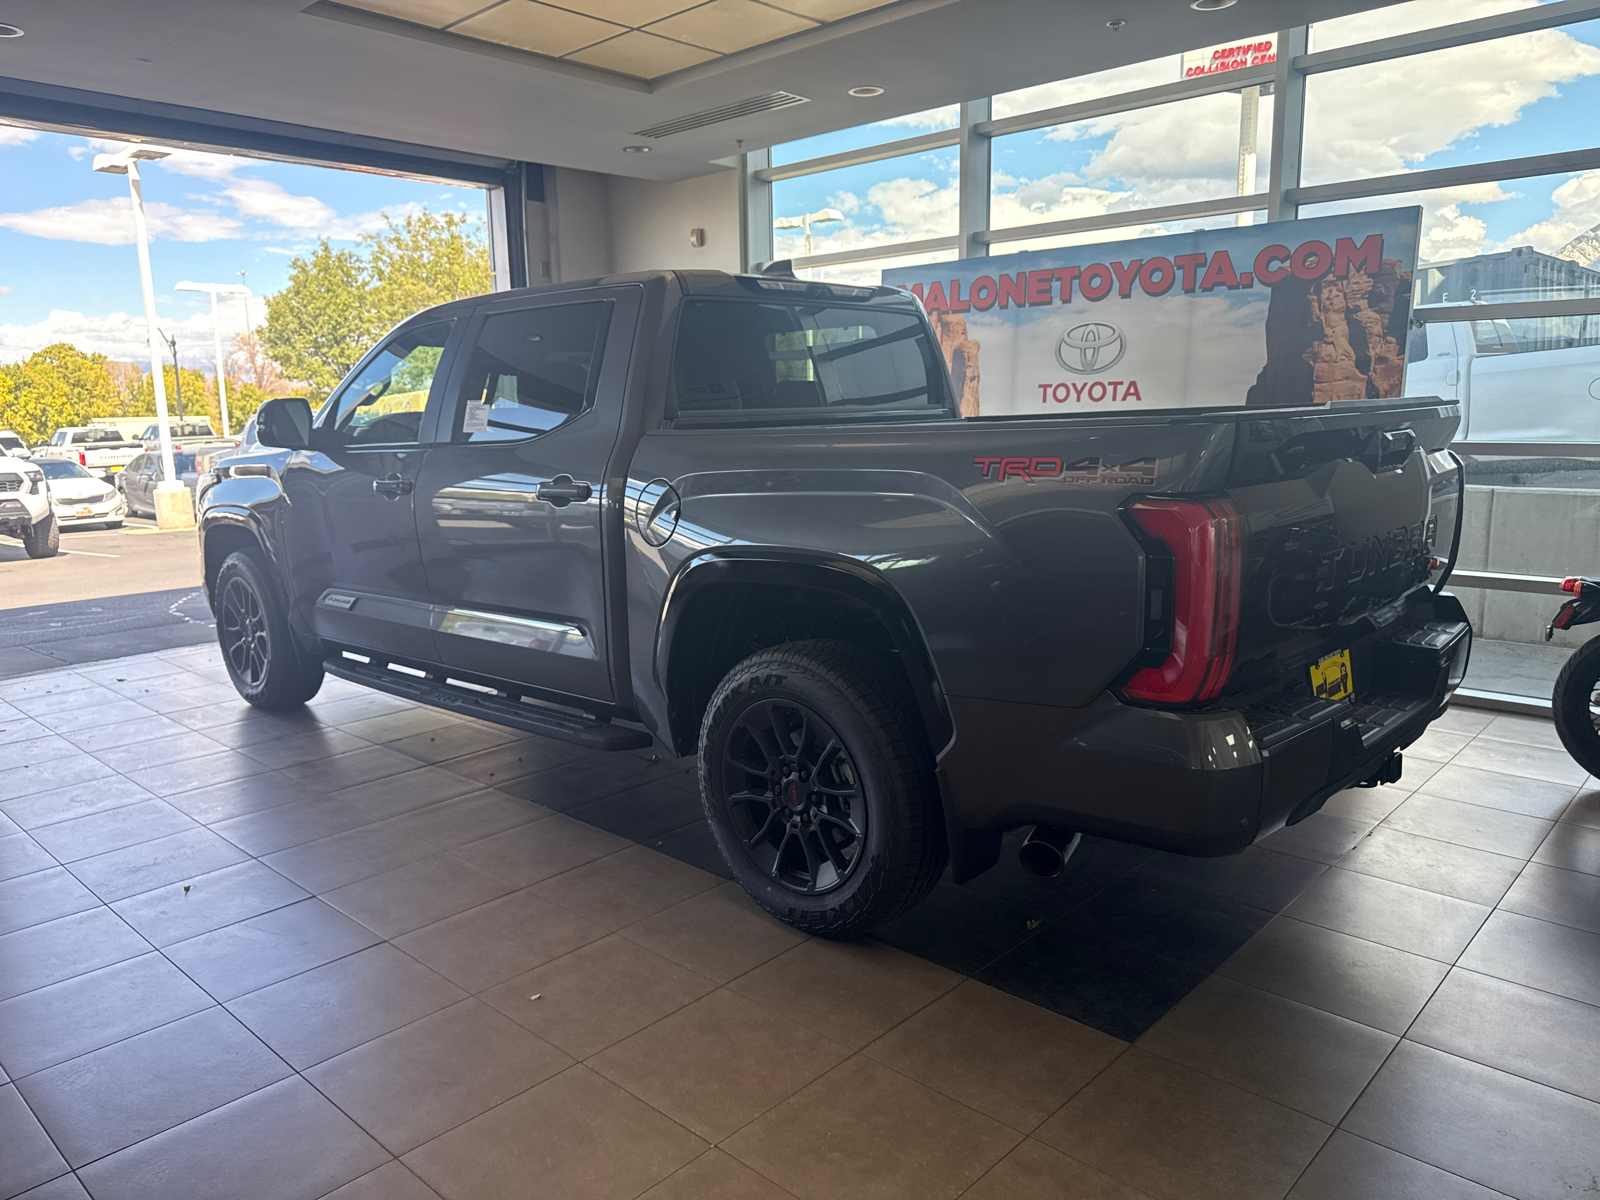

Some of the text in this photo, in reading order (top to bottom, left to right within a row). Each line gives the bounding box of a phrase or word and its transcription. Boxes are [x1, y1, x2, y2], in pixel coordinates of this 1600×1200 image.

[1212, 41, 1273, 60] CERTIFIED
[1185, 58, 1248, 77] COLLISION
[1038, 381, 1142, 403] TOYOTA
[973, 457, 1065, 486] TRD
[1063, 475, 1156, 486] OFF ROAD
[1319, 514, 1438, 593] TUNDRA
[791, 782, 799, 806] TRD
